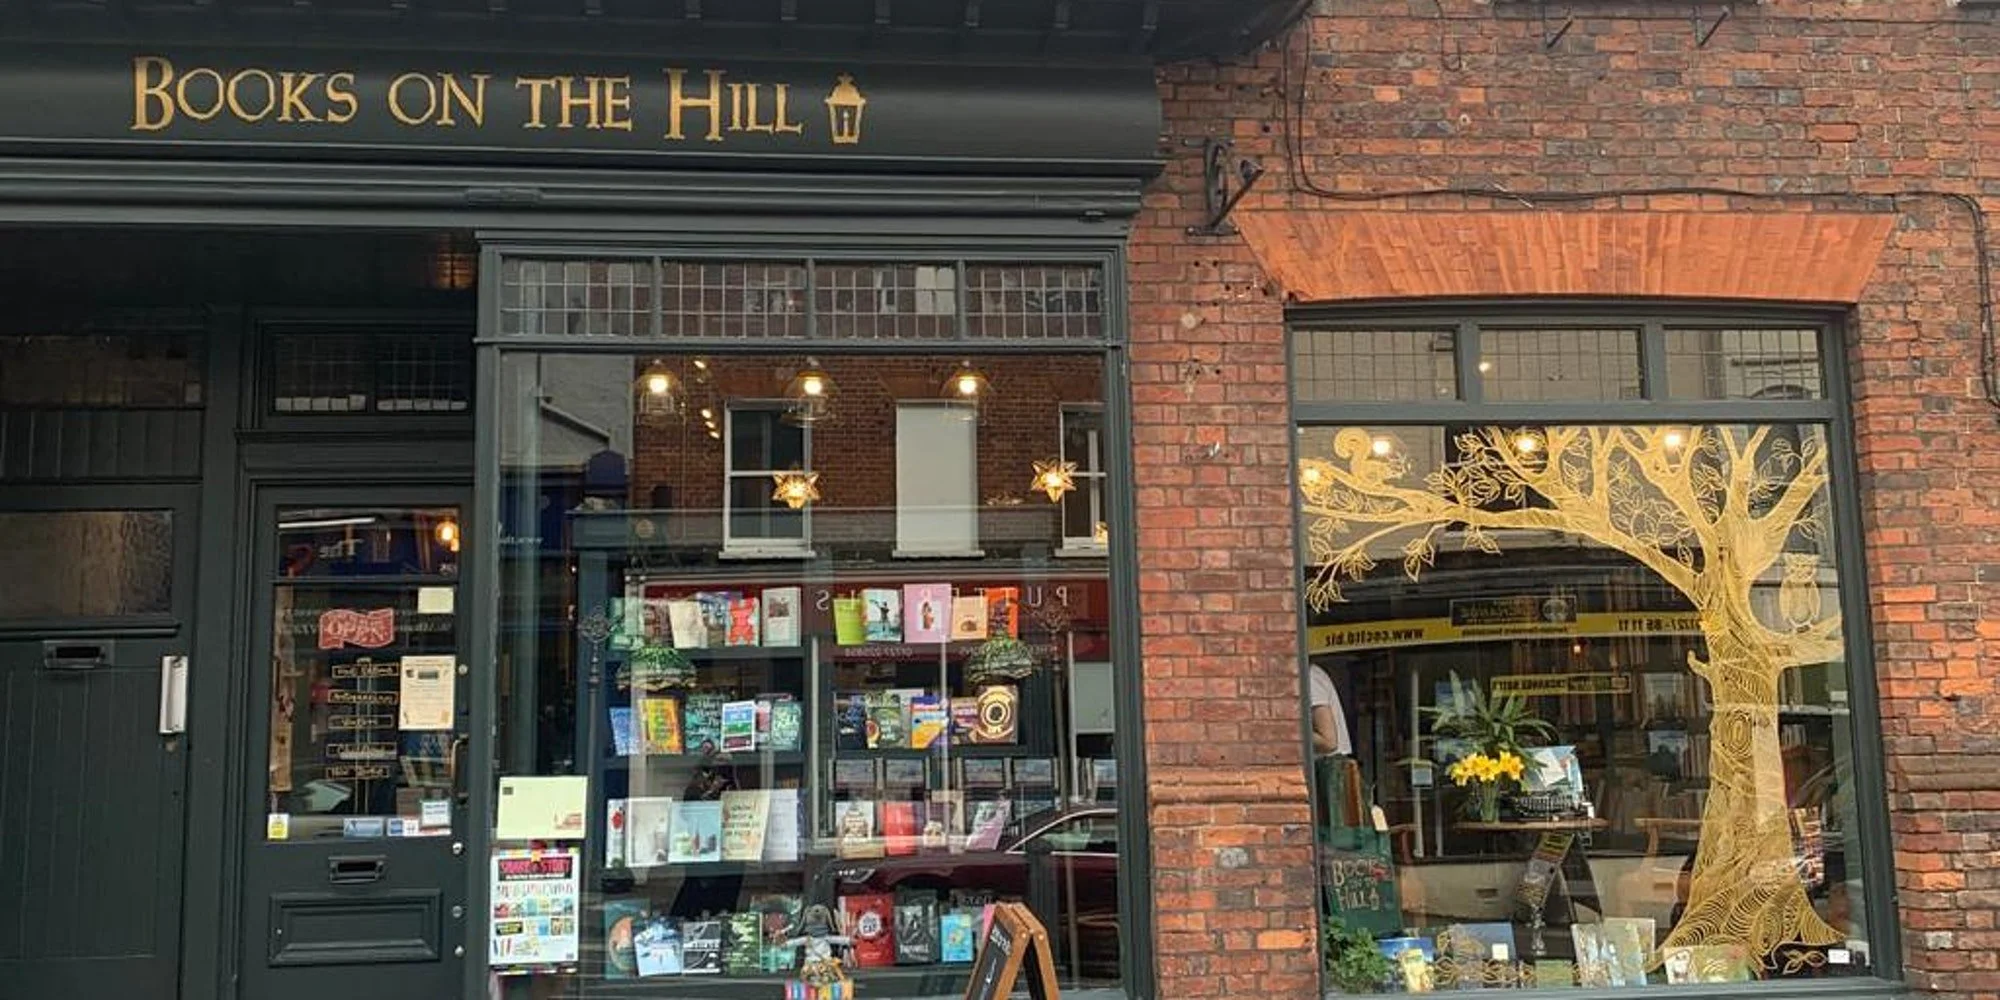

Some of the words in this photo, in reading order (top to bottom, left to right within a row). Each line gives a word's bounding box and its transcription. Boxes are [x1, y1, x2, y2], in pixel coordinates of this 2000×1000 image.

[132, 57, 358, 130] BOOKS
[387, 73, 490, 126] ON
[518, 75, 633, 131] THE
[664, 68, 803, 142] HILL
